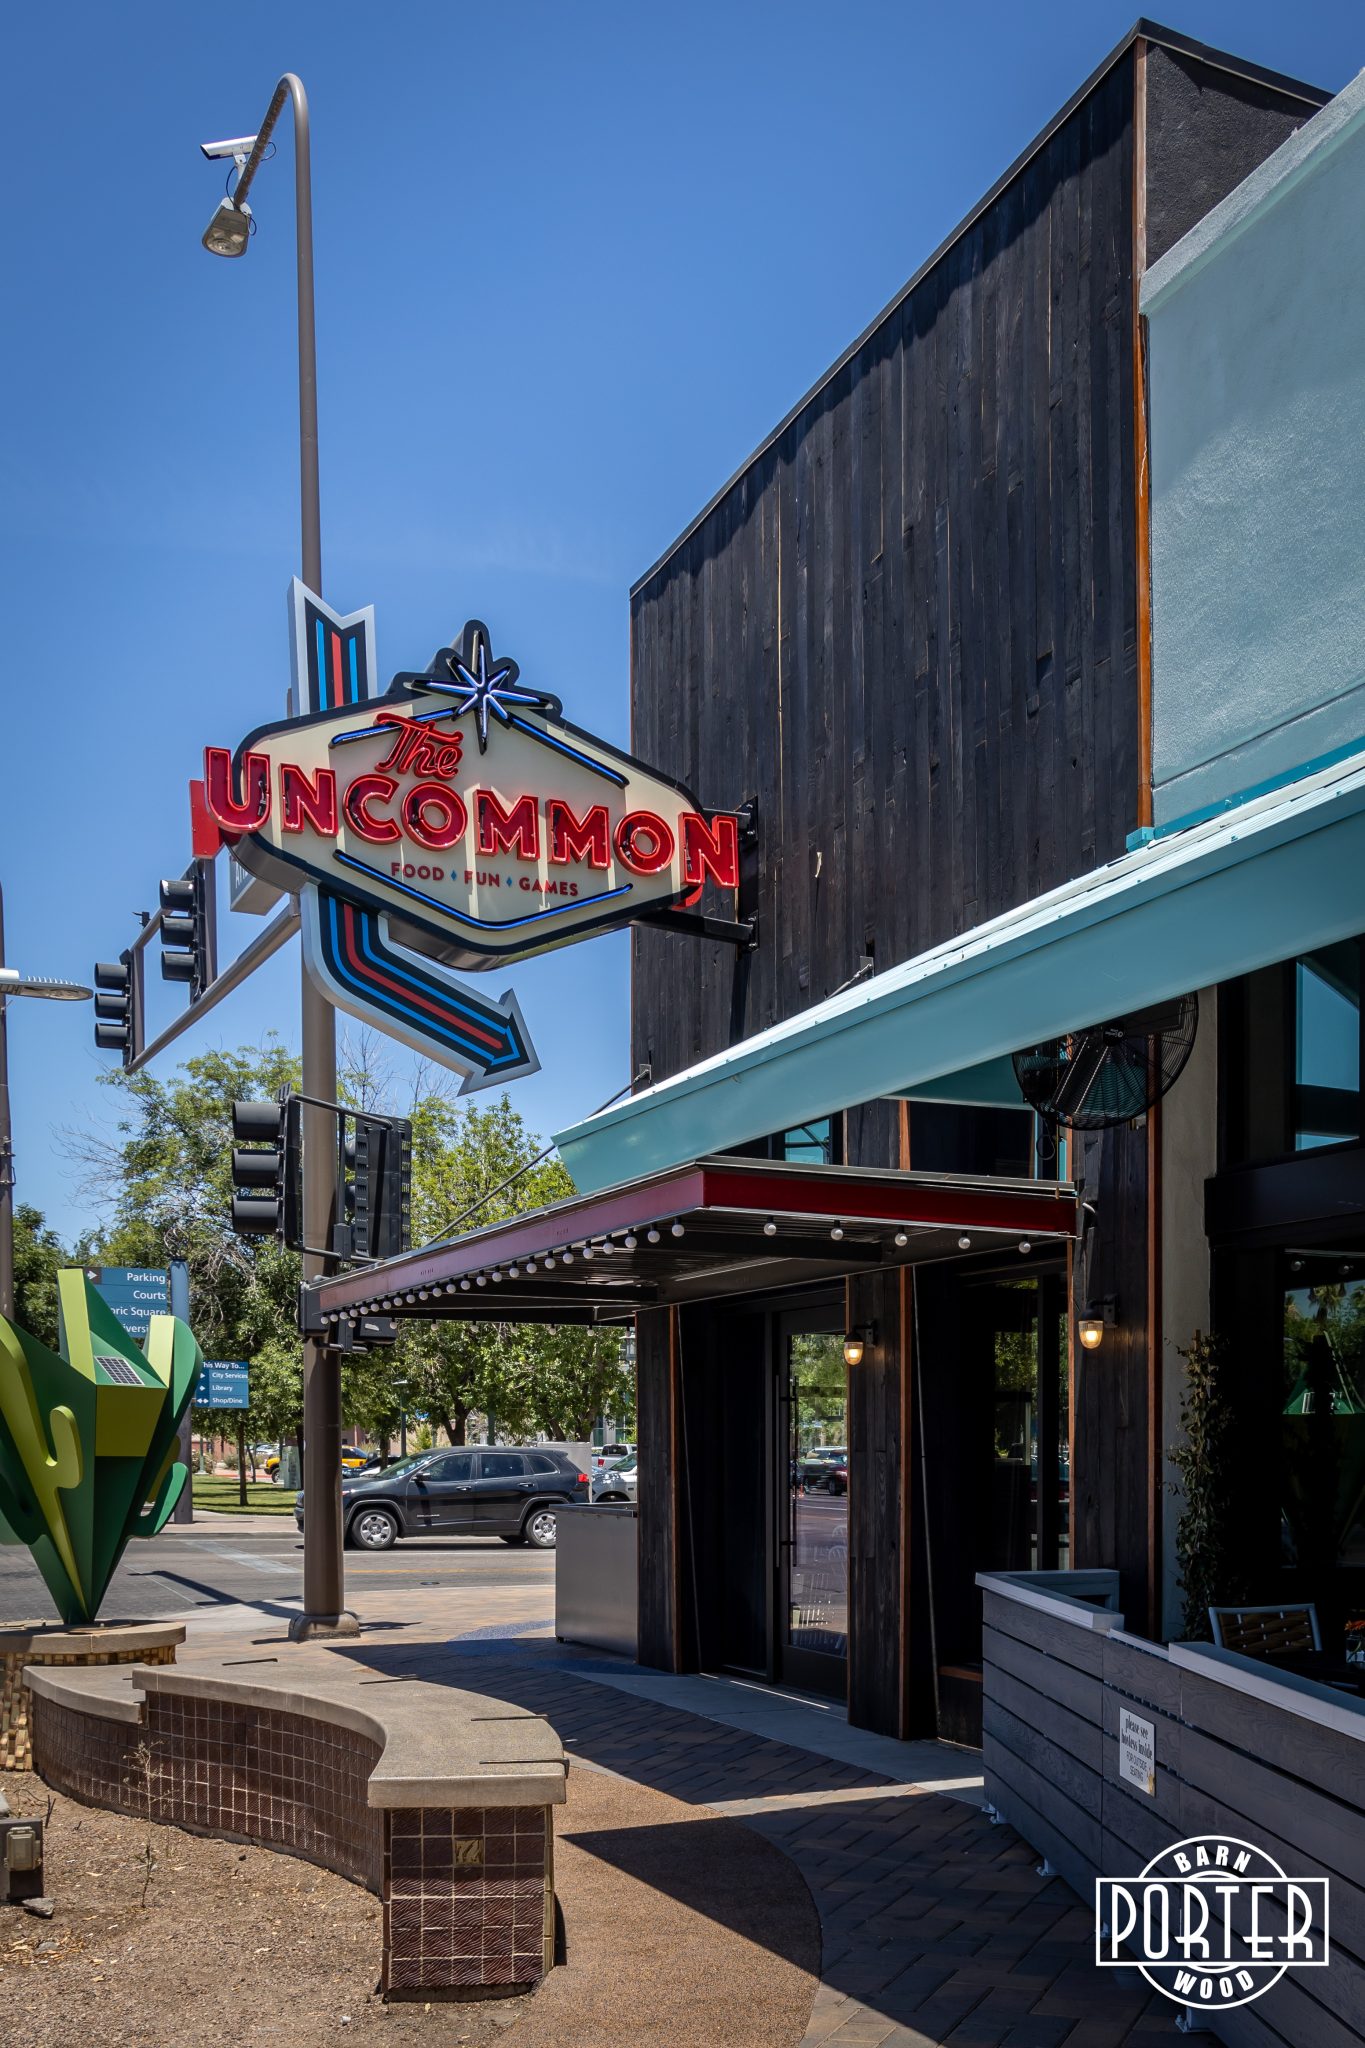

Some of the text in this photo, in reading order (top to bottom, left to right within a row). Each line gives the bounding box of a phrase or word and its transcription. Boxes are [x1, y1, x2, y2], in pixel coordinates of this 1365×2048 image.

[374, 712, 464, 781] The
[203, 745, 739, 891] UNCOMMON
[390, 862, 579, 897] FOOD FUN GAMES
[127, 1272, 166, 1285] Parking
[133, 1290, 166, 1300] Courts
[110, 1306, 166, 1318] oric Square
[214, 1361, 230, 1370] Way
[212, 1384, 233, 1392] Library
